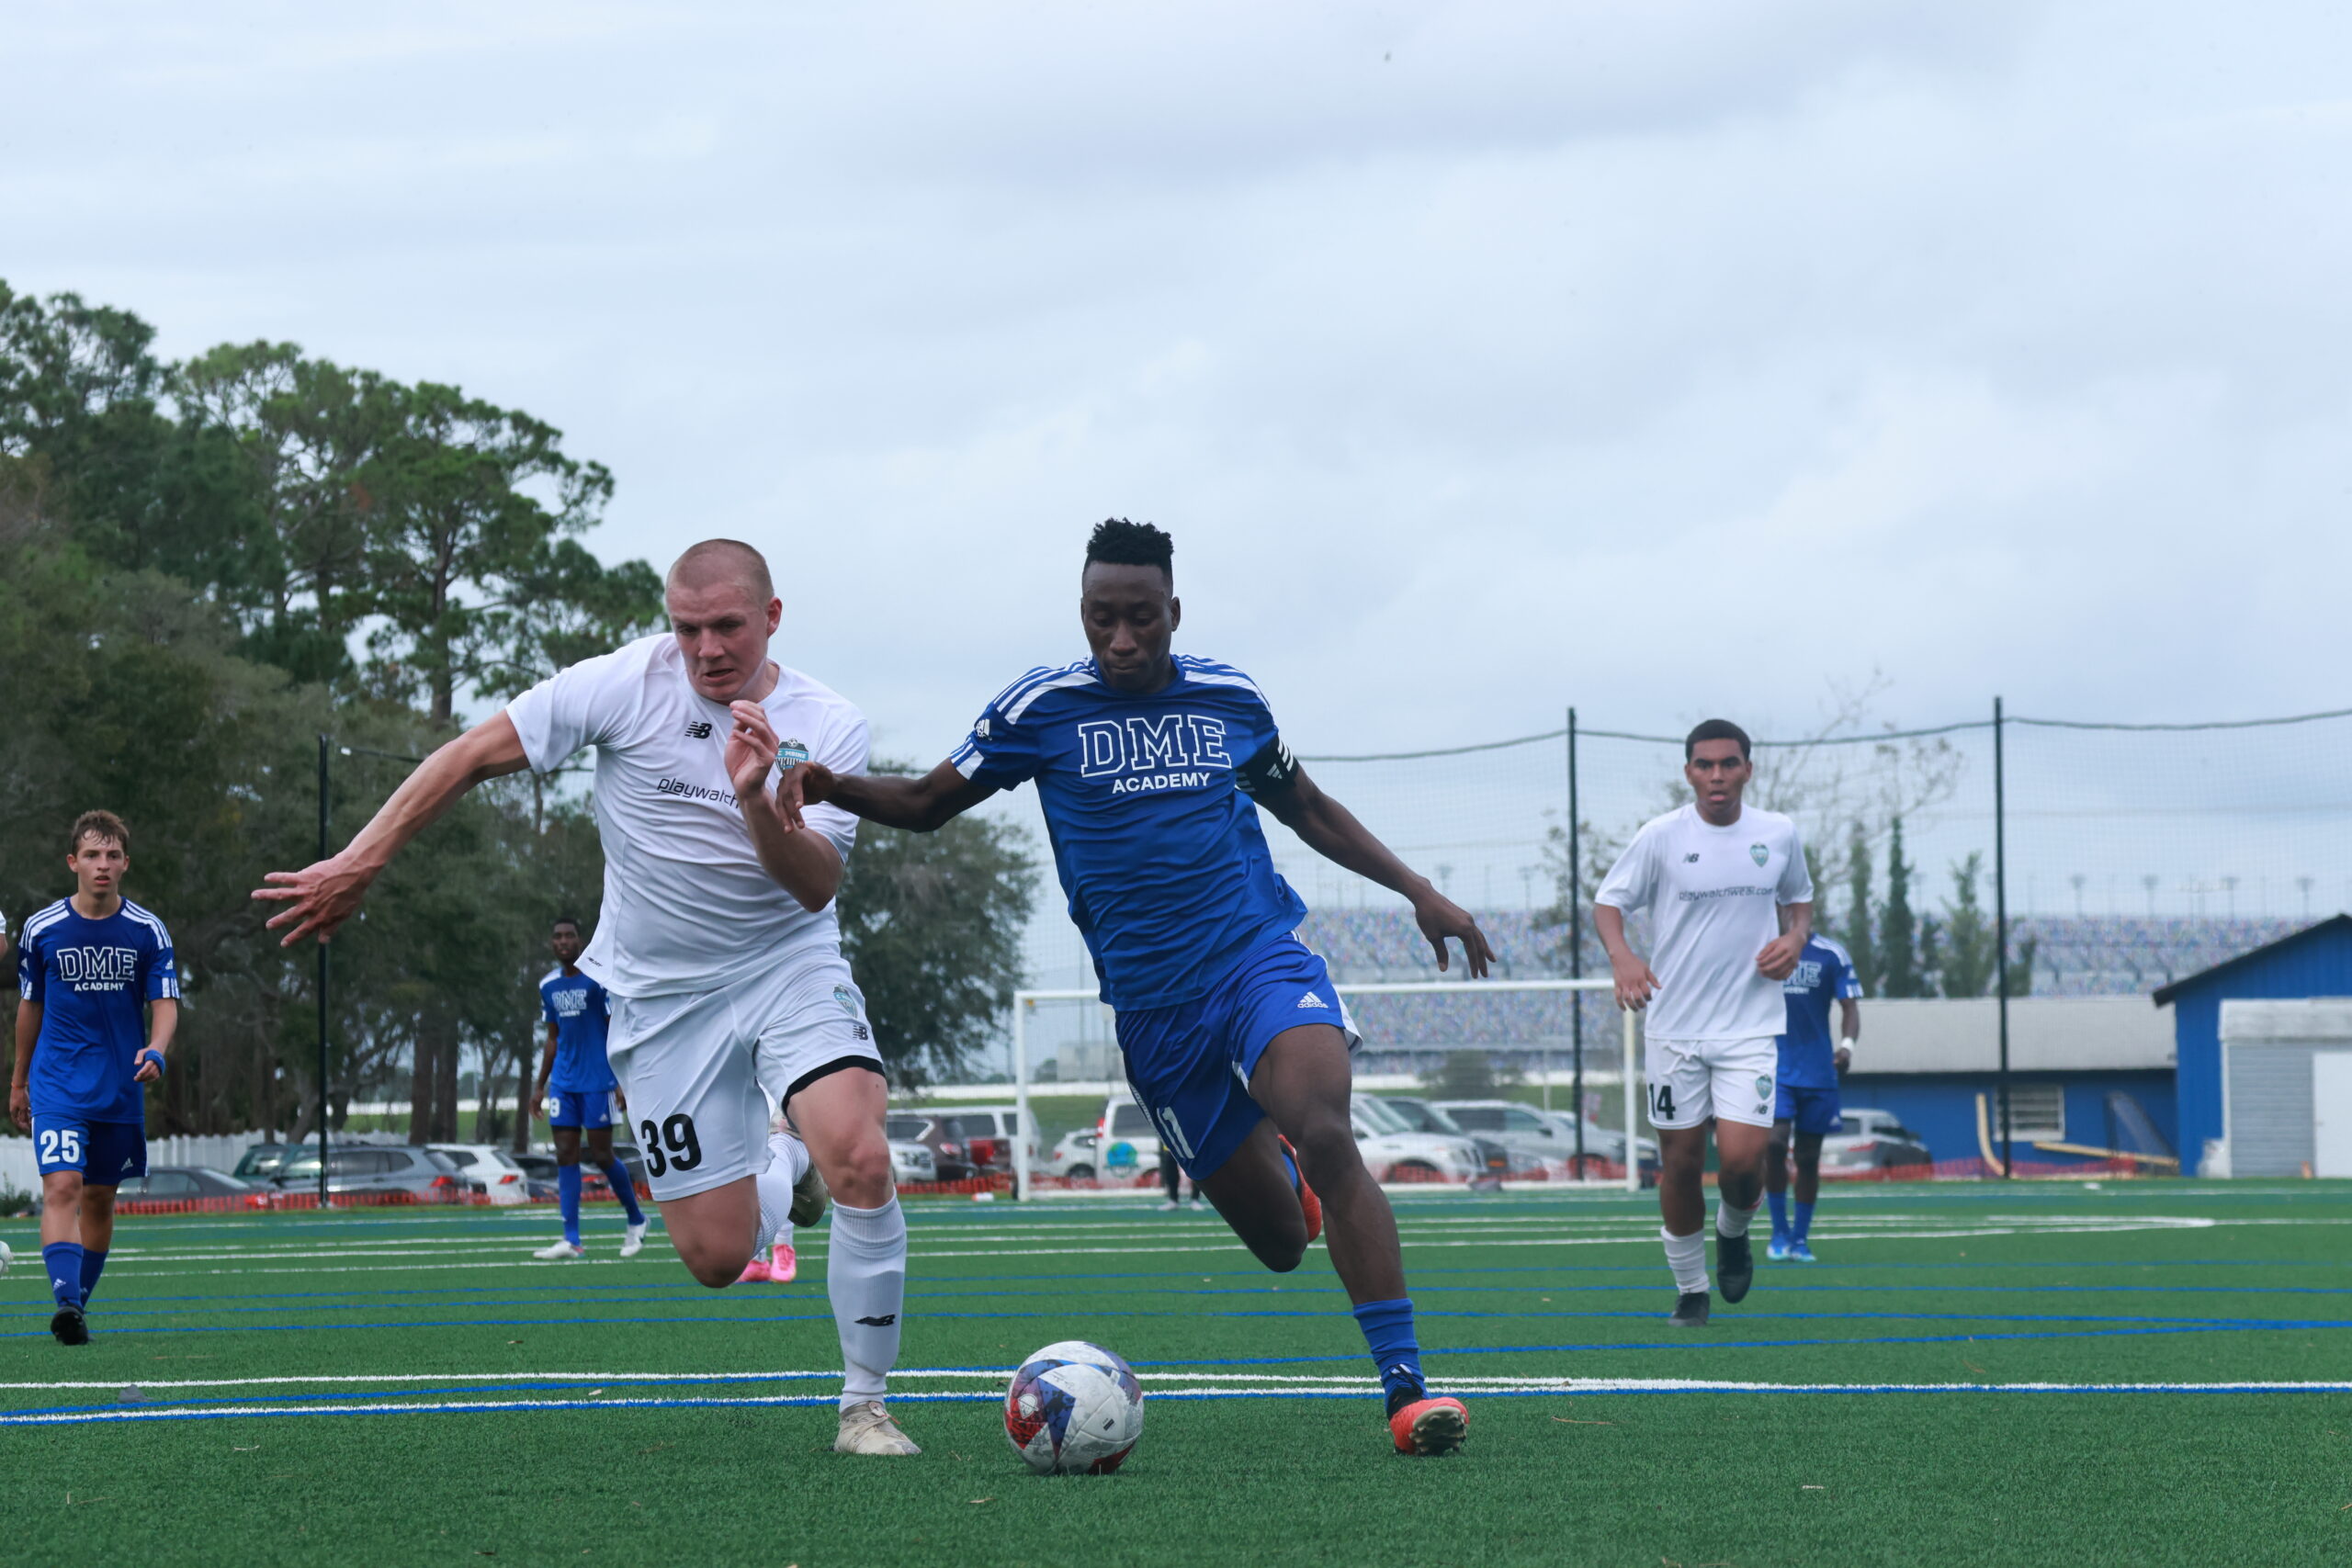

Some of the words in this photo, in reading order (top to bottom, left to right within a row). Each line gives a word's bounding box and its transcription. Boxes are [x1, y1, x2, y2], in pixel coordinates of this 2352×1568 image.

[1078, 714, 1232, 778] DME
[1112, 773, 1210, 794] ACADEMY
[56, 946, 138, 981] DME
[74, 982, 125, 991] ACADEMY
[1649, 1083, 1677, 1120] 14
[40, 1129, 80, 1165] 25
[640, 1113, 702, 1178] 39
